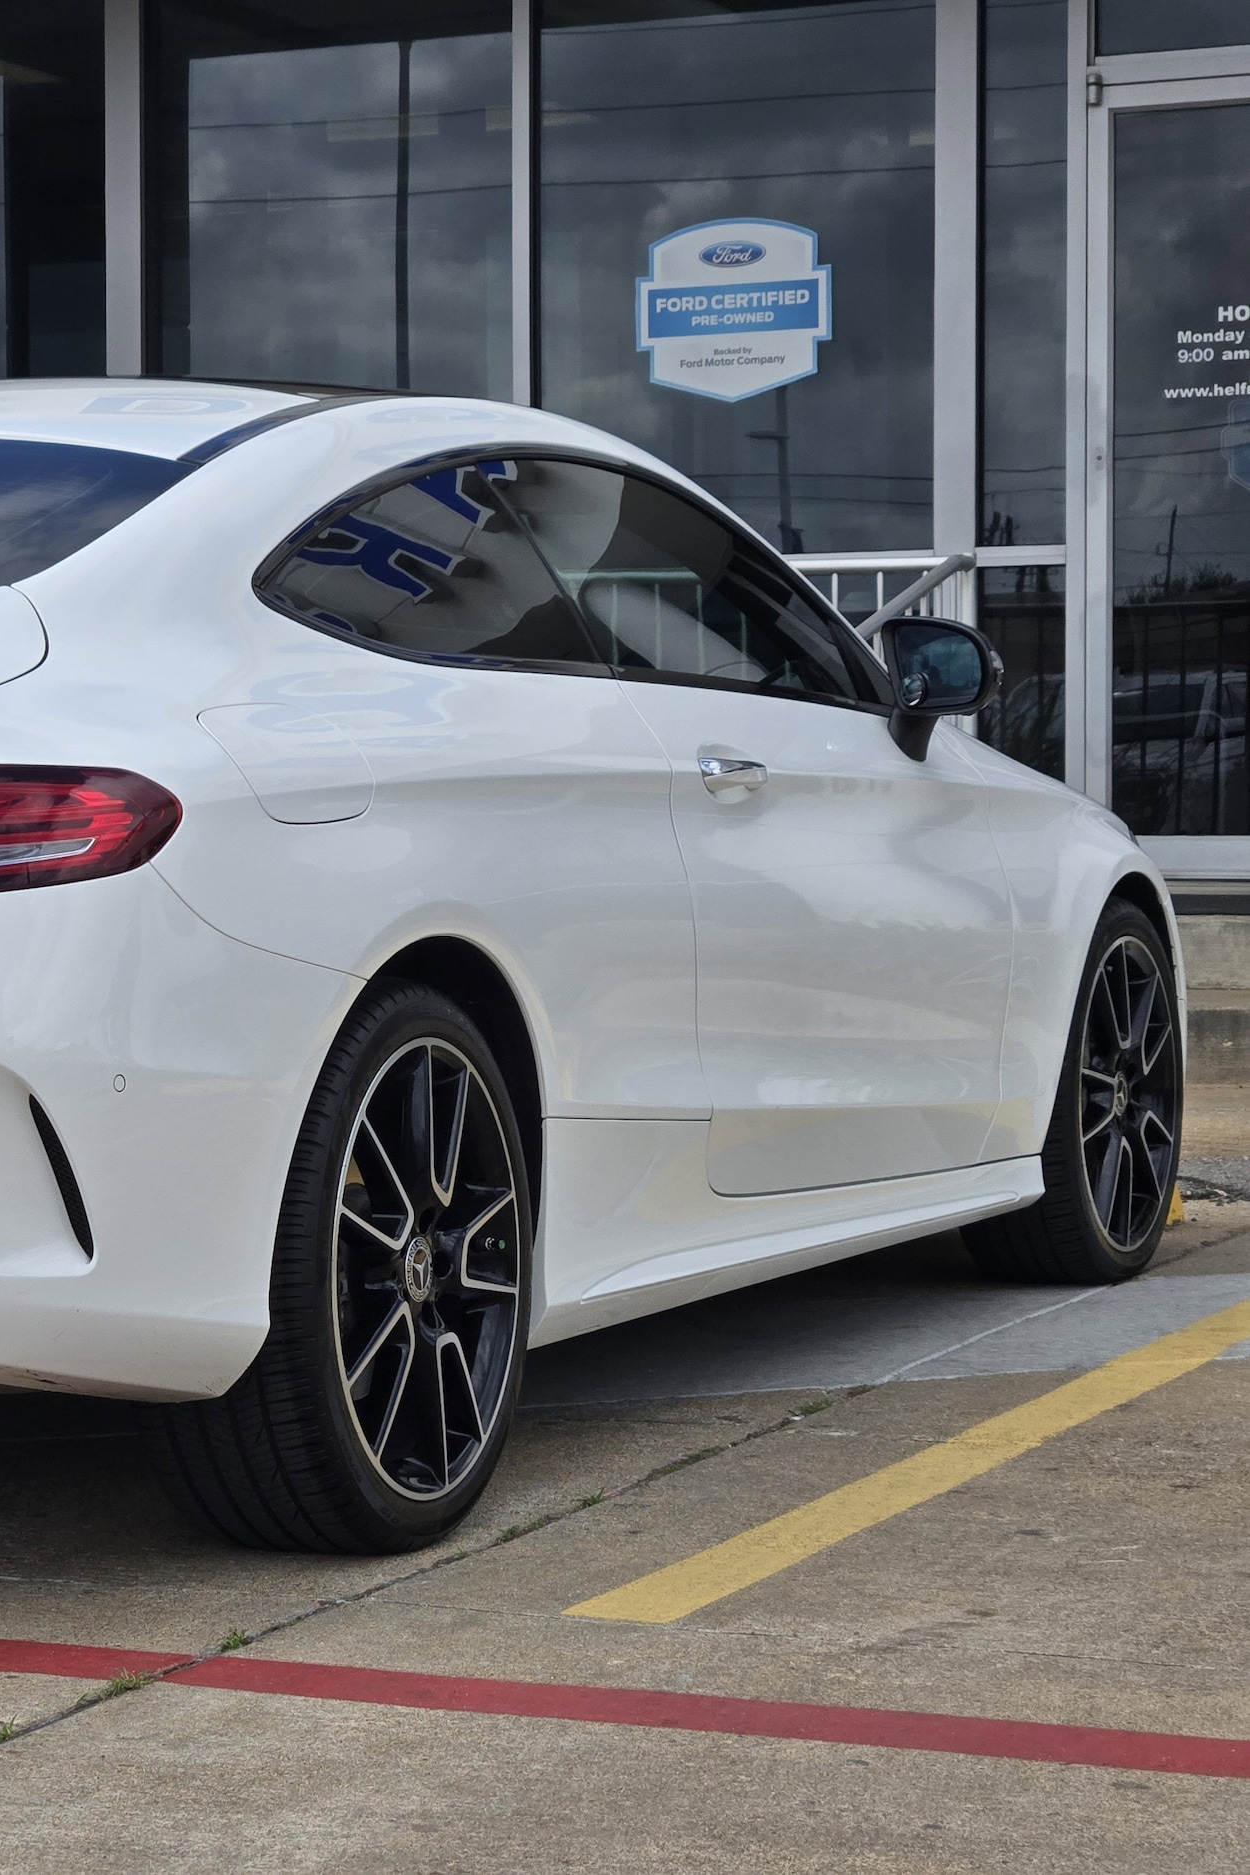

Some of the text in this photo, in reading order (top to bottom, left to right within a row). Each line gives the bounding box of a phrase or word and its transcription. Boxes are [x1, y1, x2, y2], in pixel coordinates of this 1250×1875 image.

[712, 244, 752, 263] Ford
[656, 289, 810, 313] FORD CERTIFIED
[691, 311, 774, 327] PRE-OWNED
[1177, 329, 1245, 344] Monday
[743, 347, 752, 355] by
[1177, 348, 1249, 363] 9:00 am
[680, 355, 785, 368] Ford Motor Company
